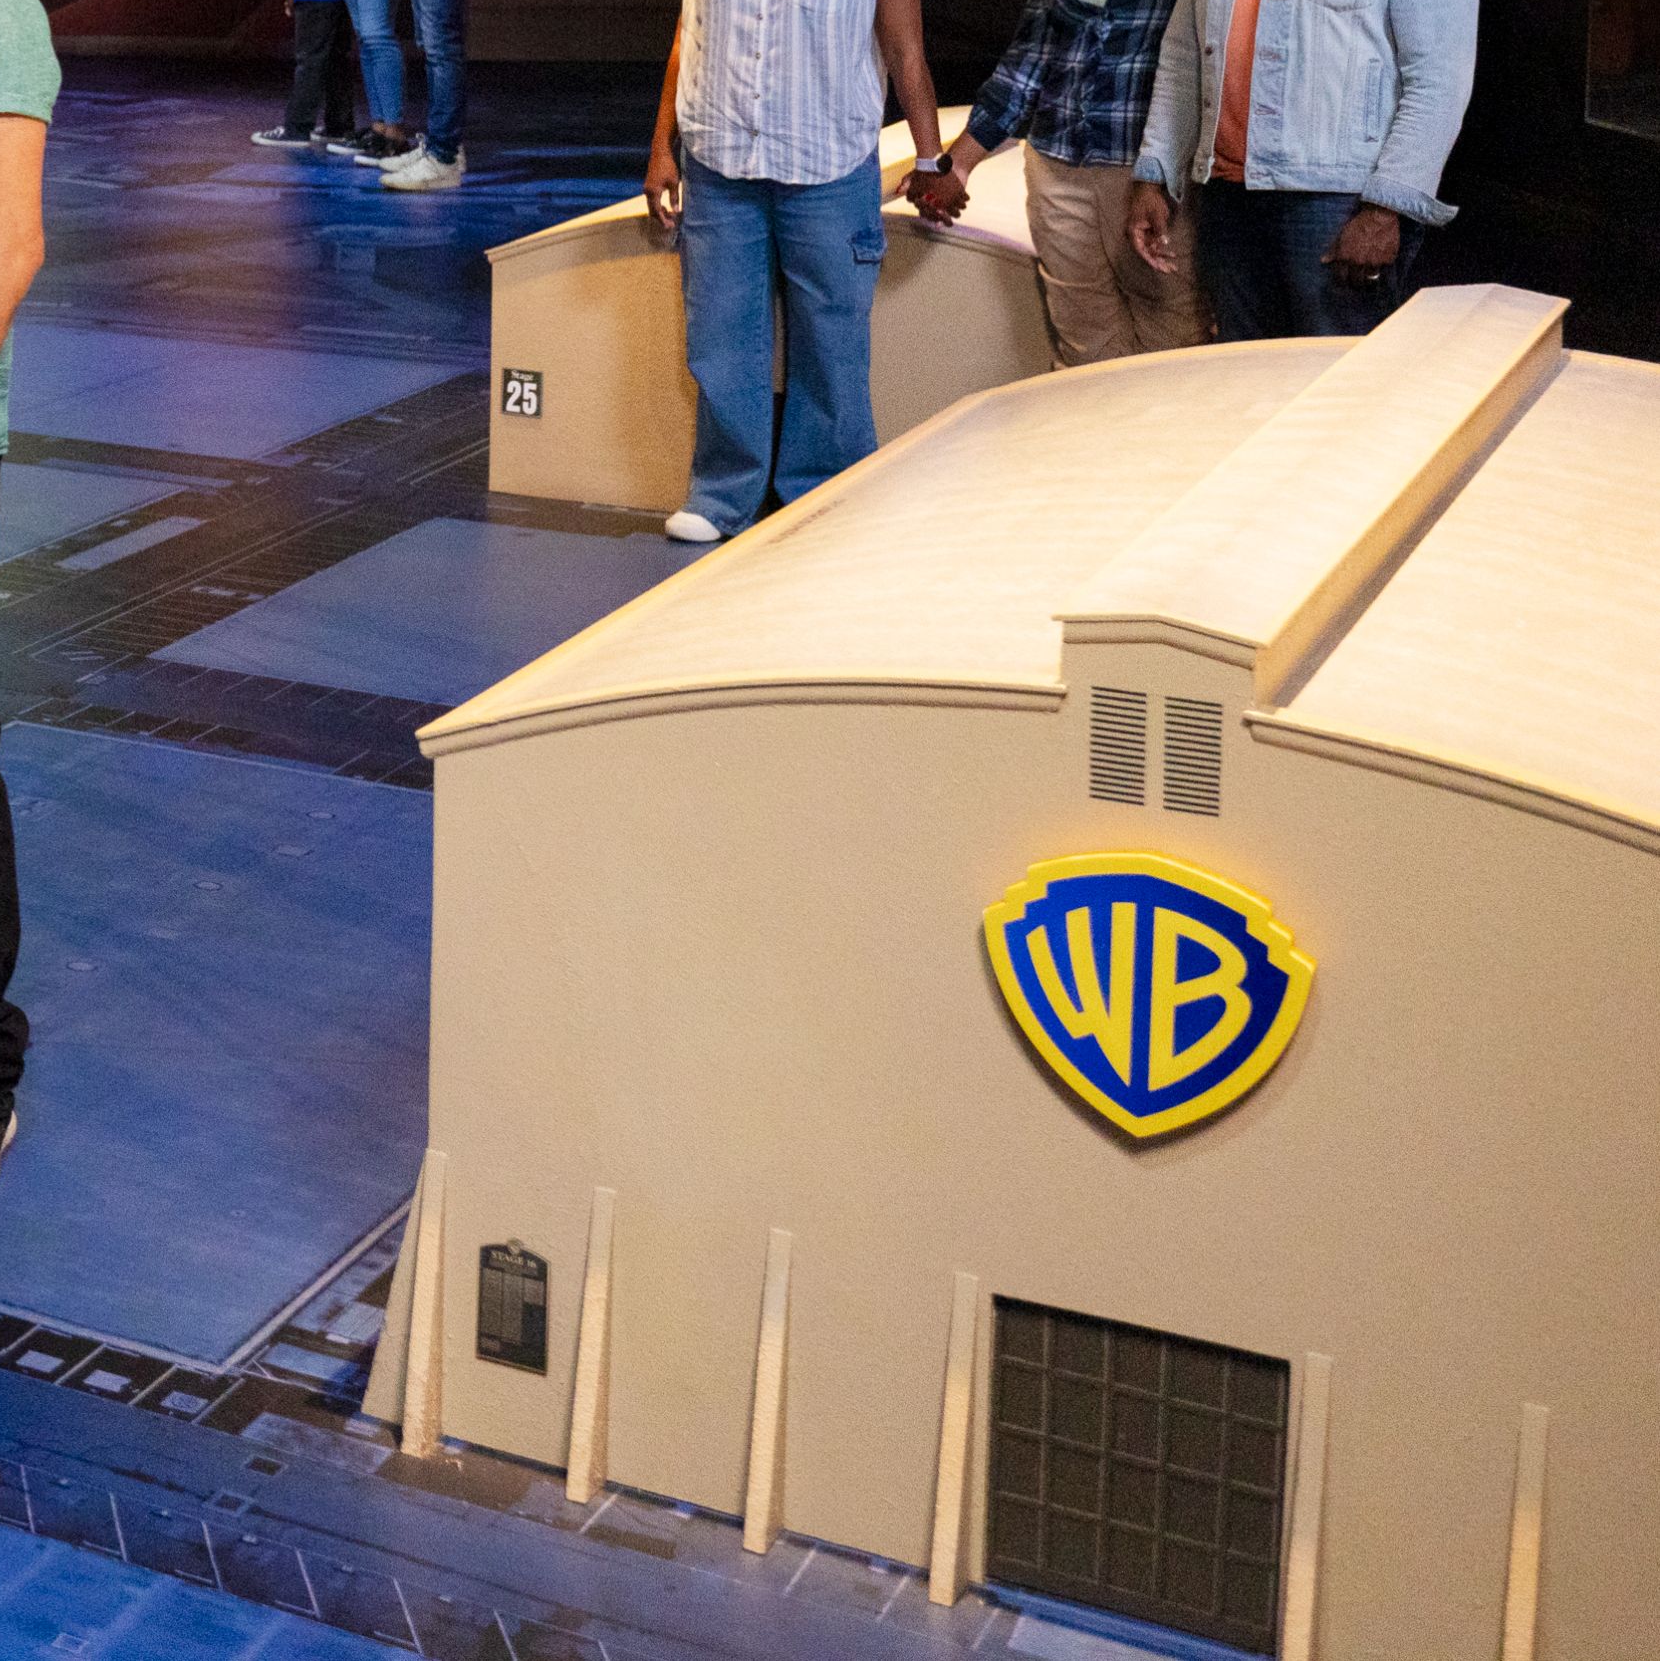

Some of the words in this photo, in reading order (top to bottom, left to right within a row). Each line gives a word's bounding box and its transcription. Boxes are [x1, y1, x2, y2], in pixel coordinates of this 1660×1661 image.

[506, 380, 538, 415] 25
[1026, 901, 1253, 1092] WB
[490, 1251, 524, 1265] STAGE
